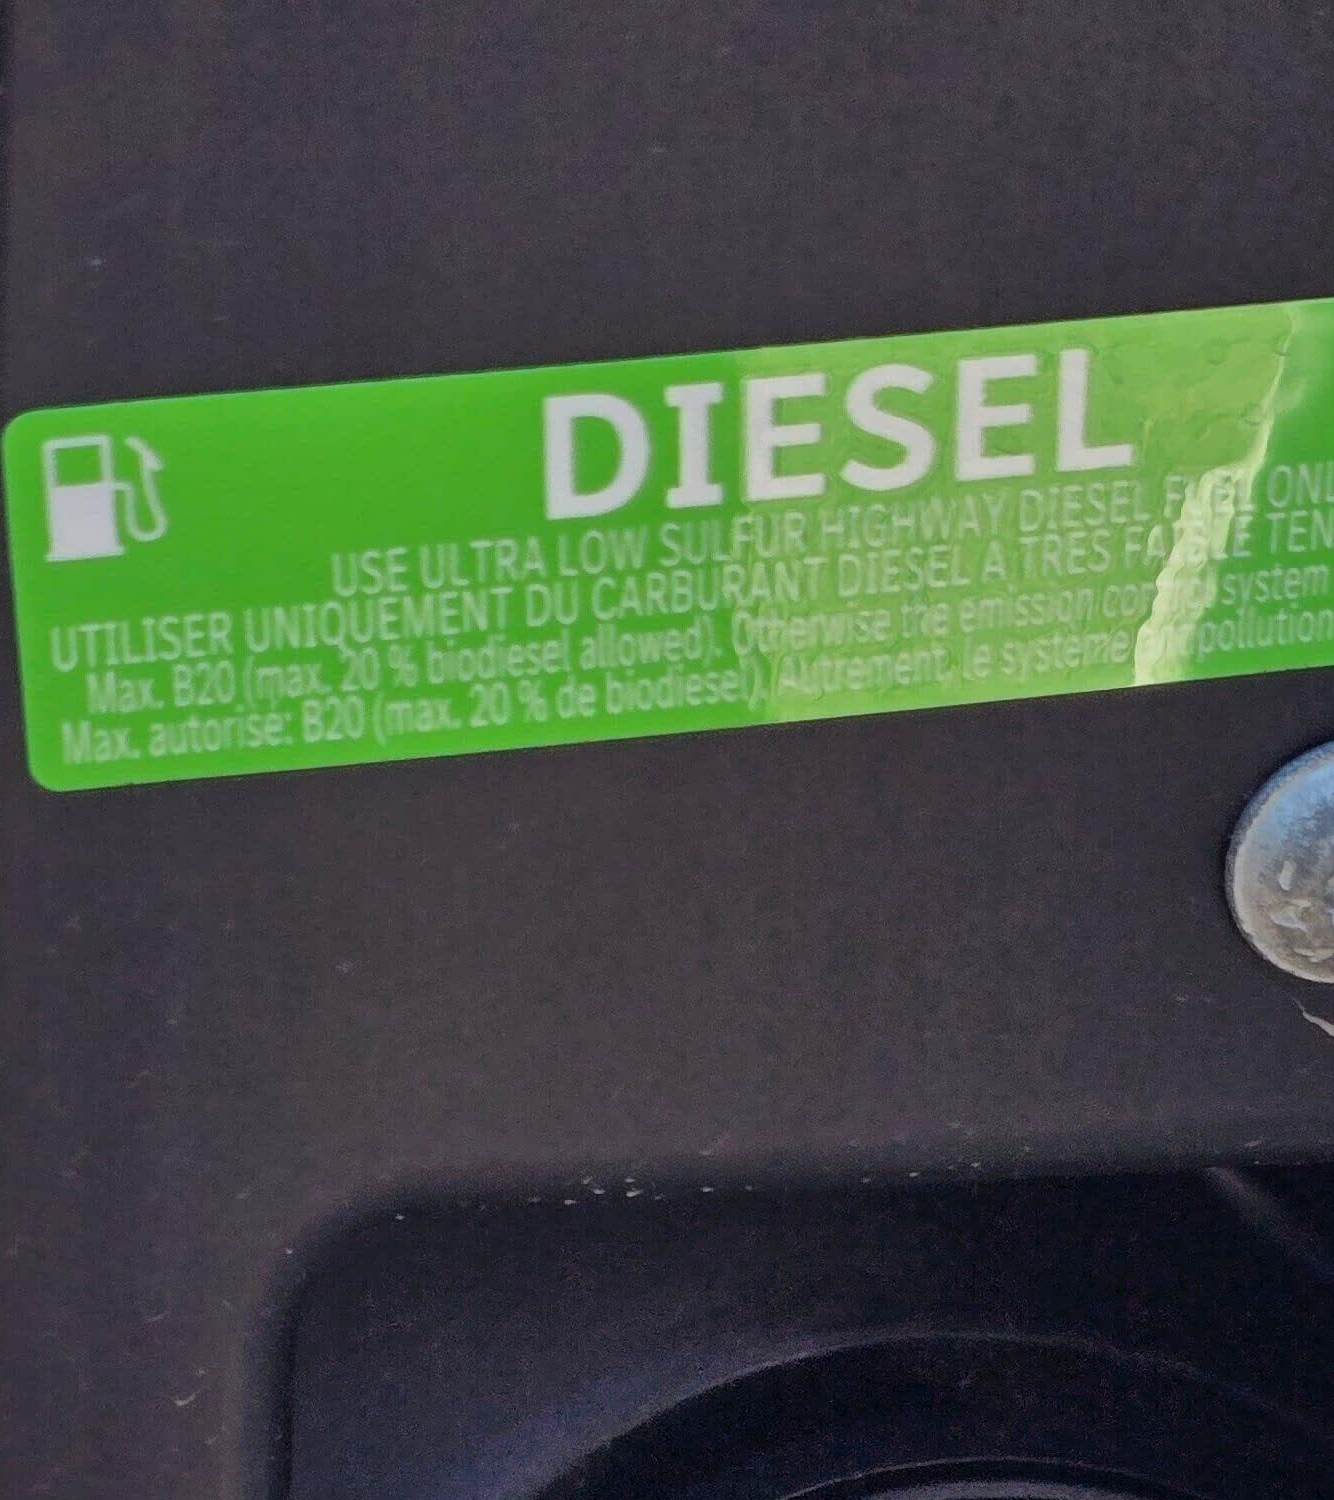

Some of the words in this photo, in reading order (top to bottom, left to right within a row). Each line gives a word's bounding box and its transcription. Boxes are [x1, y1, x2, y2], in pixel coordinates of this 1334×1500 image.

[543, 348, 1135, 520] DIESEL
[331, 547, 408, 597] USE
[419, 536, 543, 588] ULTRA
[559, 526, 649, 577] LOW
[659, 513, 807, 567] SULFUR
[821, 494, 1014, 549] HIGHWAY
[1019, 481, 1152, 534] DIESEL
[1164, 466, 1255, 518] FEL
[49, 610, 233, 671] UTILISER
[244, 588, 513, 654] UNIQUEMENT
[526, 581, 579, 627] DU
[591, 556, 828, 621] CARBURANT
[838, 544, 970, 598] DIESEL
[86, 670, 164, 715] Max.
[173, 660, 236, 707] B20
[242, 656, 333, 707] (max.
[340, 648, 380, 692] 20
[388, 645, 418, 687] %
[427, 630, 569, 685] biodiesel
[579, 615, 722, 680] allowed).
[959, 582, 1094, 634] emission
[1104, 563, 1218, 618] conol
[1221, 559, 1330, 610] system
[62, 719, 140, 765] Max.
[302, 697, 365, 745] B20
[373, 692, 462, 747] (max.
[470, 683, 510, 728] 20
[517, 681, 549, 722] %
[556, 676, 596, 719] de
